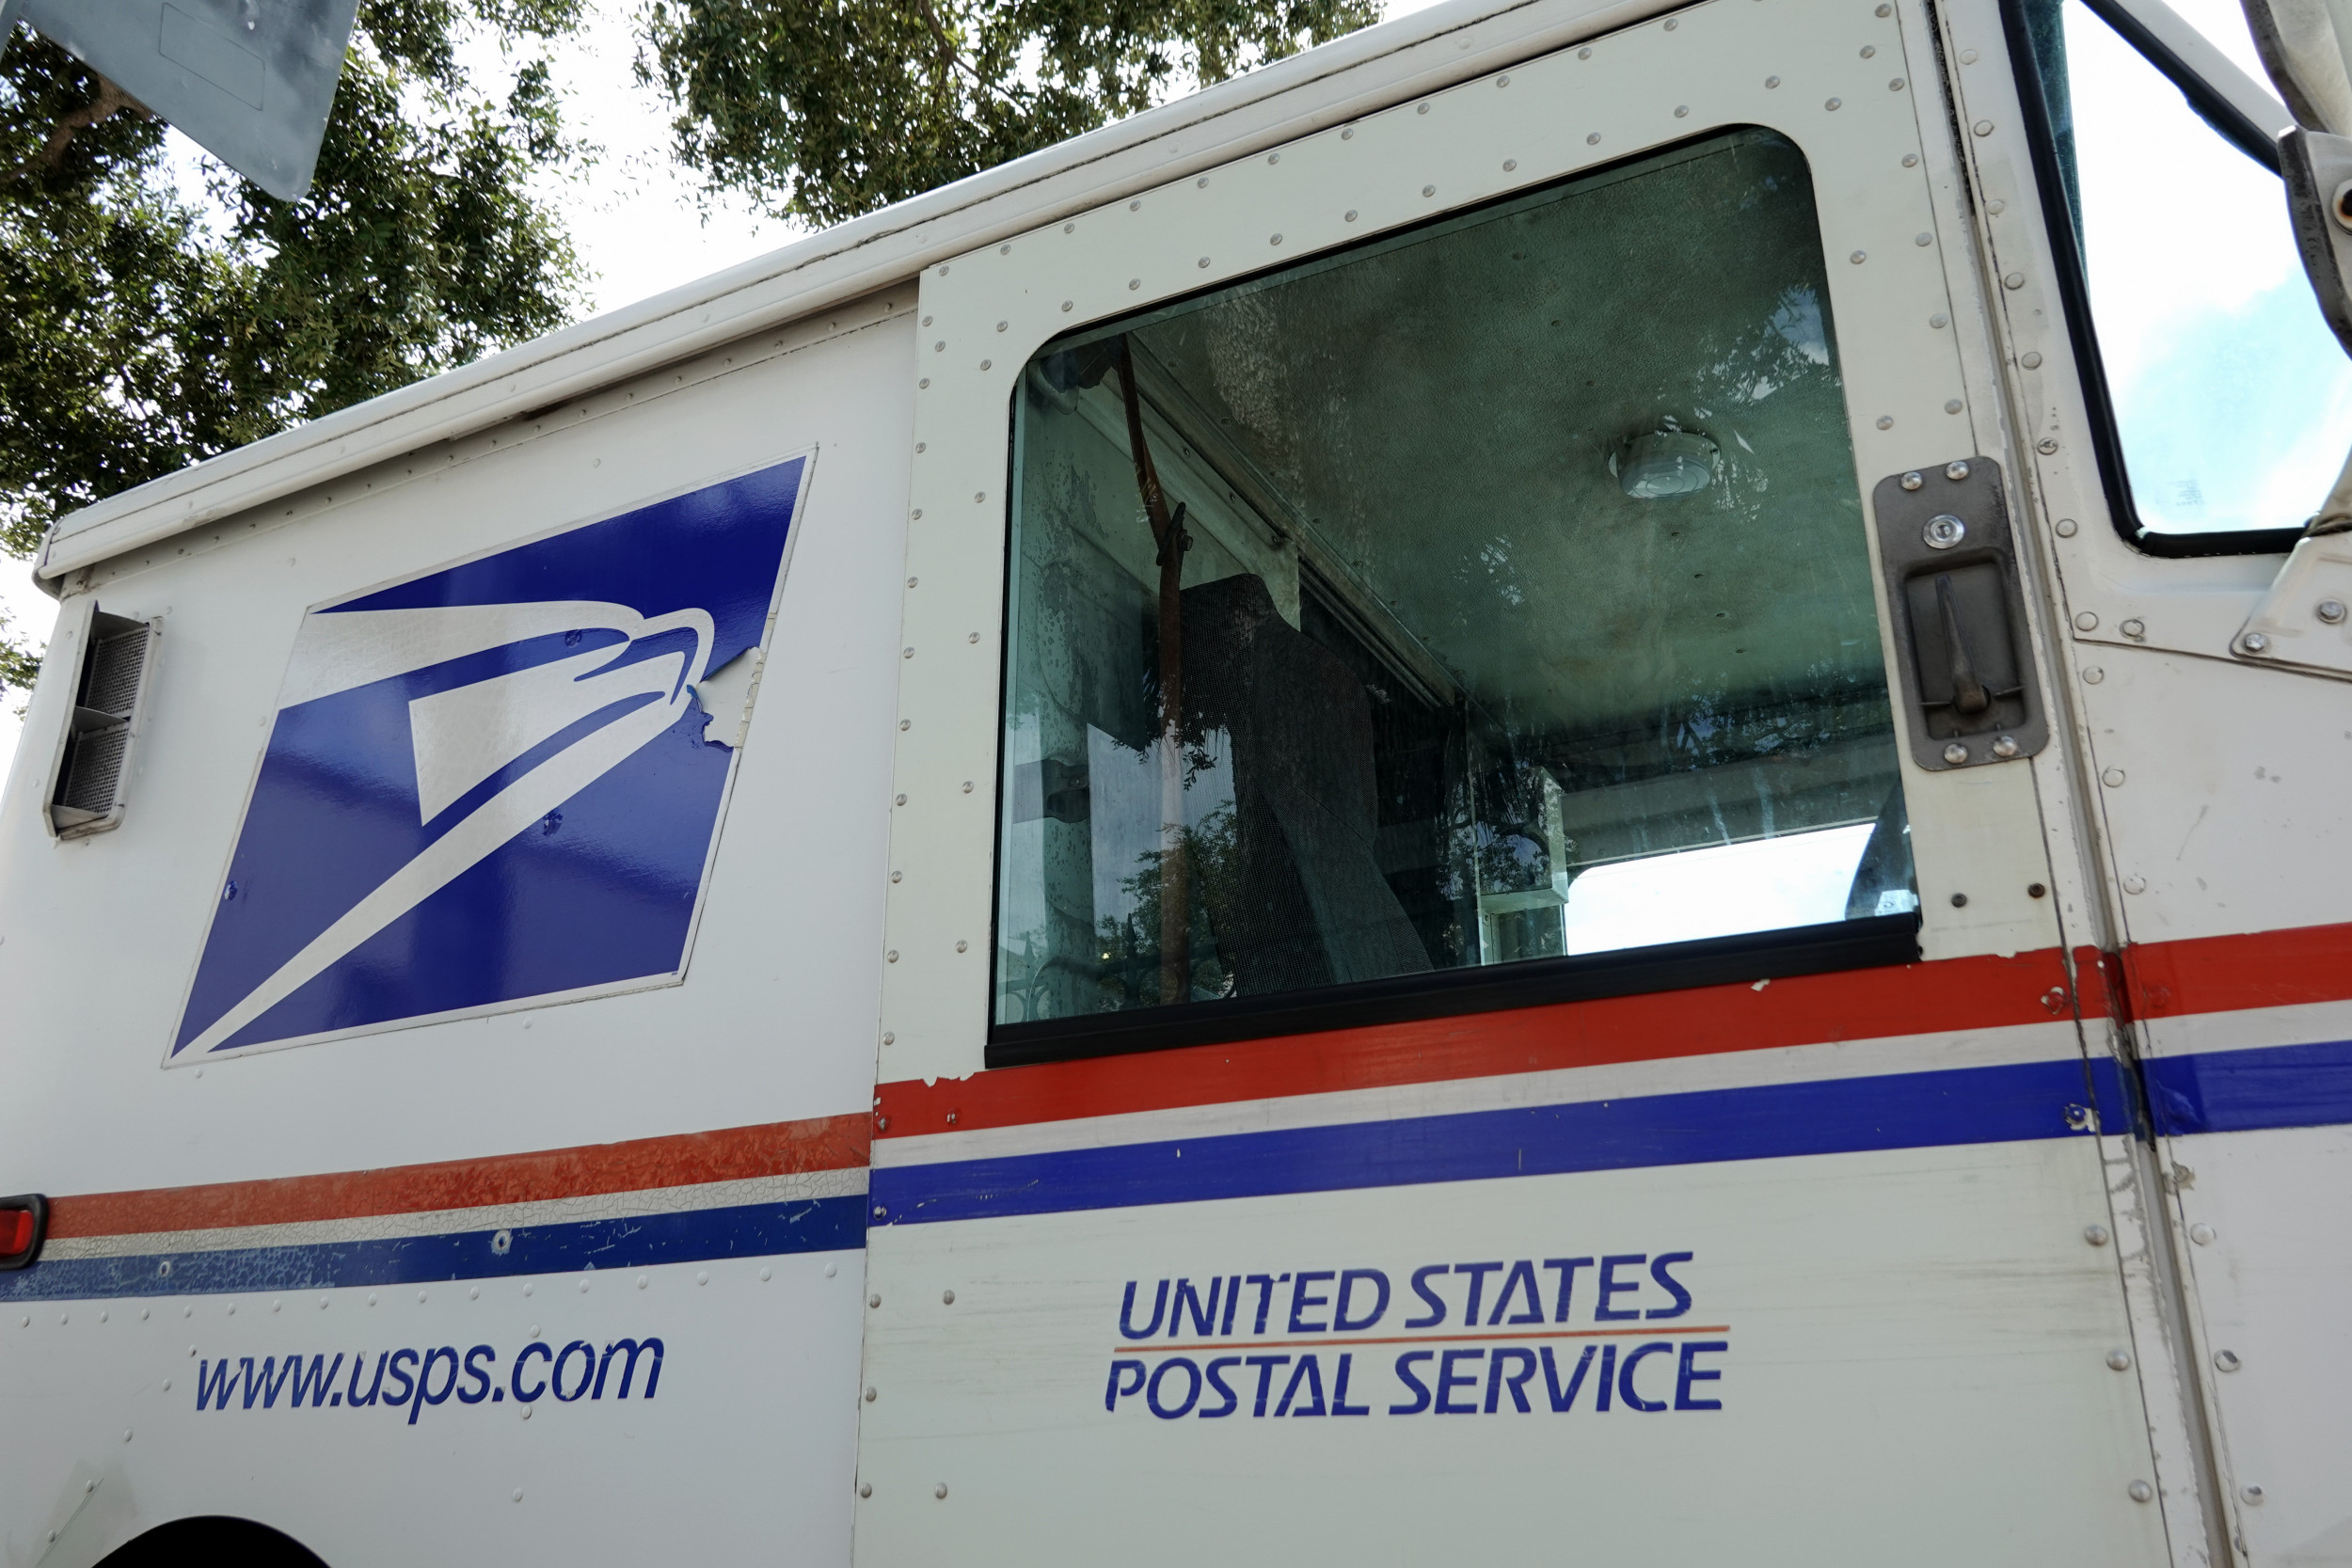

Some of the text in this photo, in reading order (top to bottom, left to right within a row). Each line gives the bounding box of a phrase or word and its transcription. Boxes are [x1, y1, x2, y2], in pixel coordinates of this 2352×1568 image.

[1119, 1251, 1693, 1339] UNITED STATES
[196, 1337, 665, 1425] www.usps.com
[1104, 1340, 1728, 1419] POSTAL SERVICE
